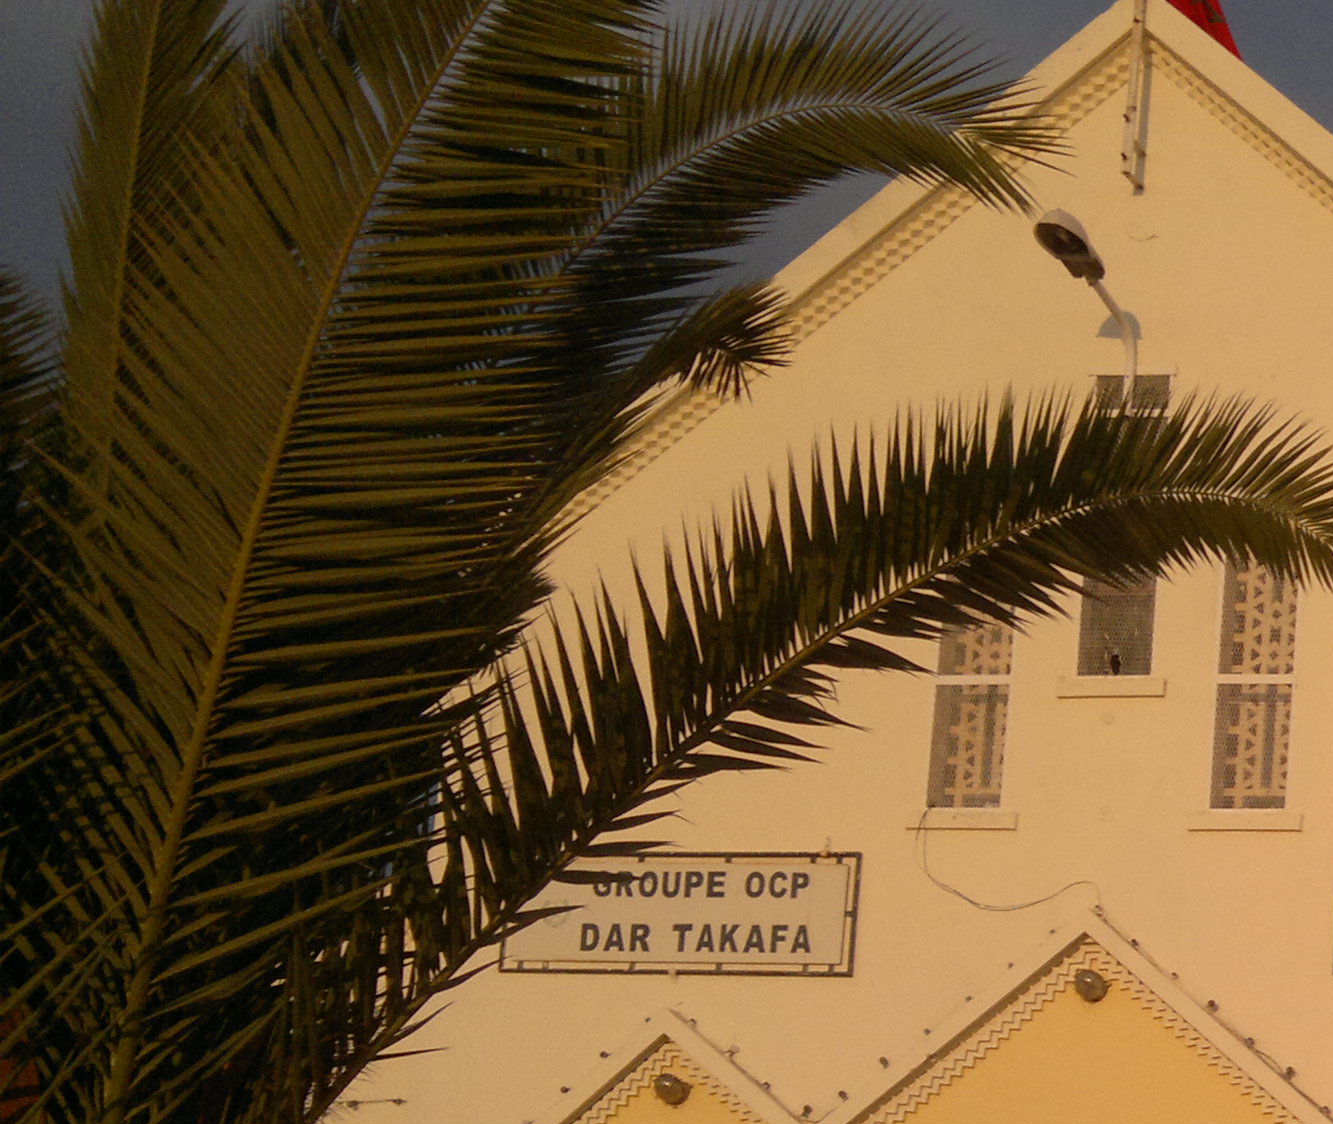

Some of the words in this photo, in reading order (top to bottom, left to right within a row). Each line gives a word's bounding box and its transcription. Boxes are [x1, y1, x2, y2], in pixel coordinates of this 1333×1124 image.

[592, 871, 726, 899] GROUPE
[744, 872, 810, 899] OCP
[579, 923, 650, 953] DAR
[673, 924, 812, 954] TAKAFA
